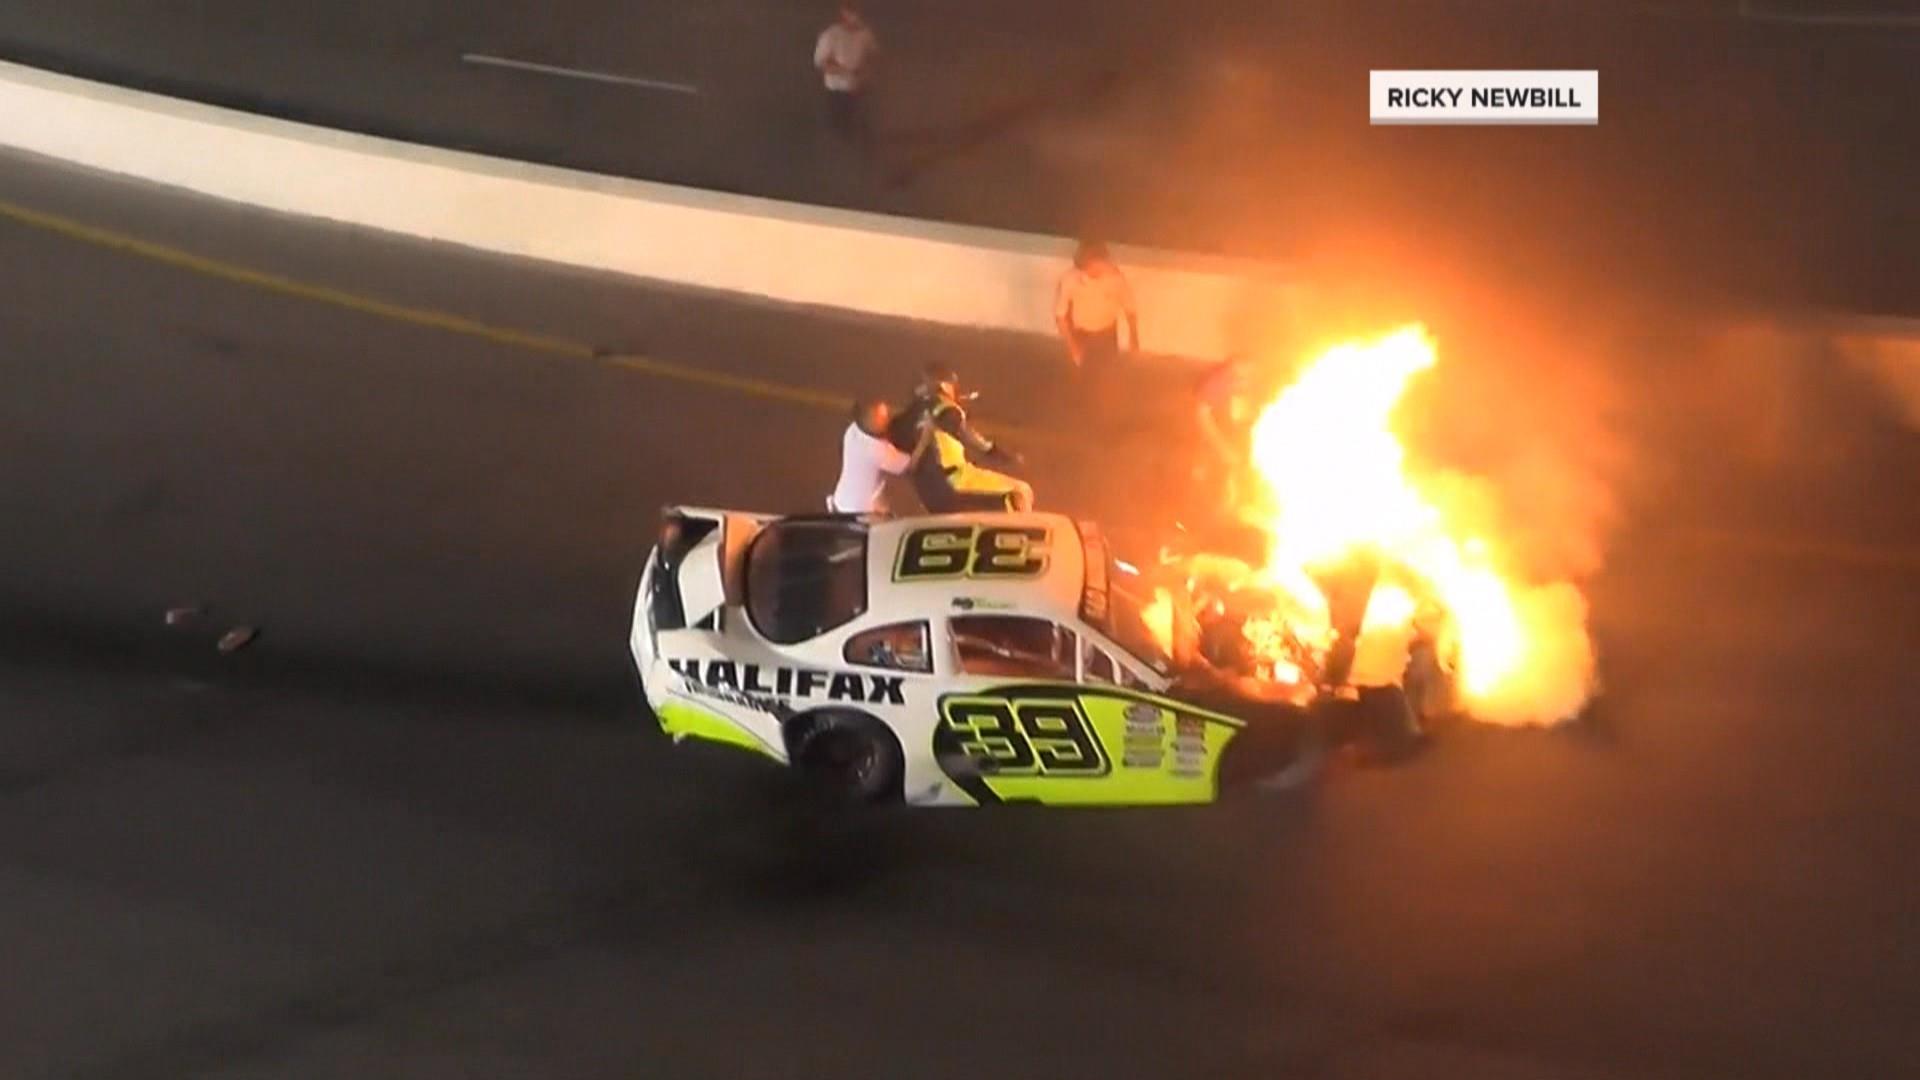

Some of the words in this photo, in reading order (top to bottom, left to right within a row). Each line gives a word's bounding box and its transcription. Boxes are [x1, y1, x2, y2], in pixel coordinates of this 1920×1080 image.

[893, 524, 1054, 583] 39
[668, 657, 907, 706] HALIFAX
[938, 694, 1112, 777] 39
